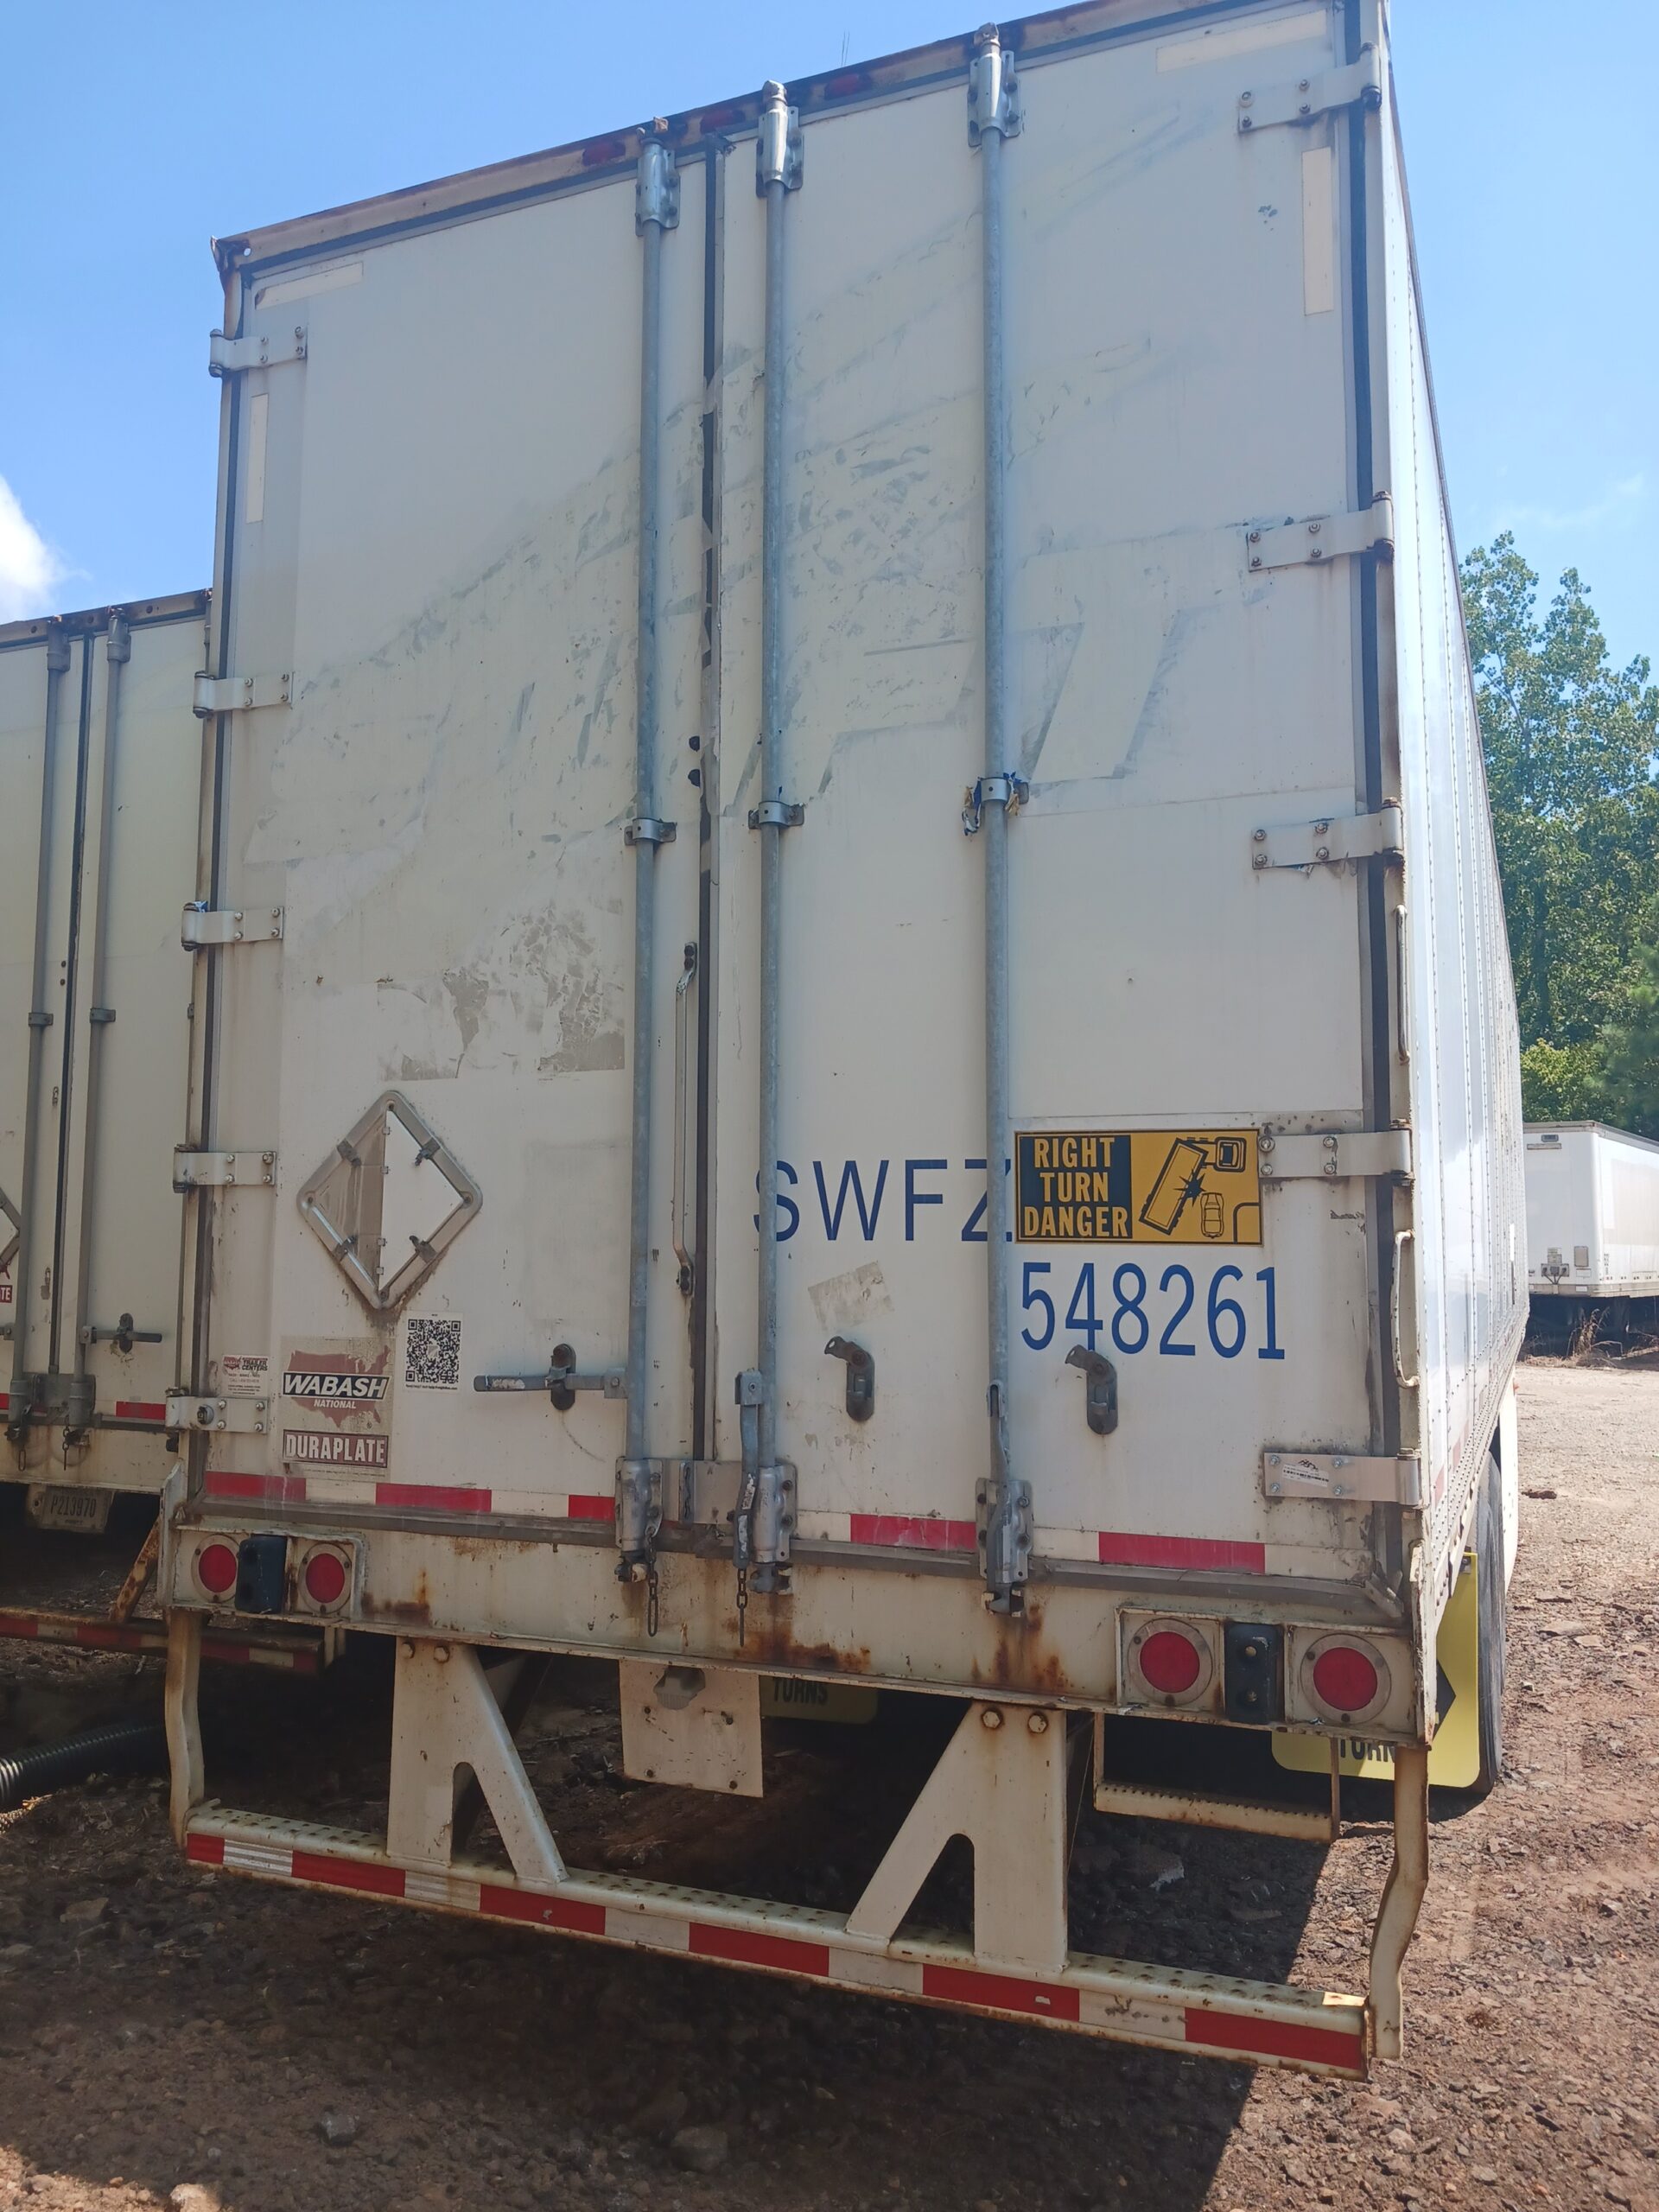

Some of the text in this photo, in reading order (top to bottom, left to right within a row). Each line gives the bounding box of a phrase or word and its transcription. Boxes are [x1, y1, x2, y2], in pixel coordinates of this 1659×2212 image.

[1033, 1137, 1115, 1168] RIGHT
[753, 1159, 1013, 1243] SWFZ
[1039, 1171, 1109, 1203] TURN
[1024, 1205, 1128, 1238] DANGER
[1021, 1262, 1286, 1360] 548261
[284, 1374, 388, 1397] WABASH
[314, 1399, 357, 1409] NATIONAL
[286, 1434, 385, 1464] DURAPLATE
[50, 1495, 97, 1518] P213970
[772, 1678, 829, 1706] TURNS
